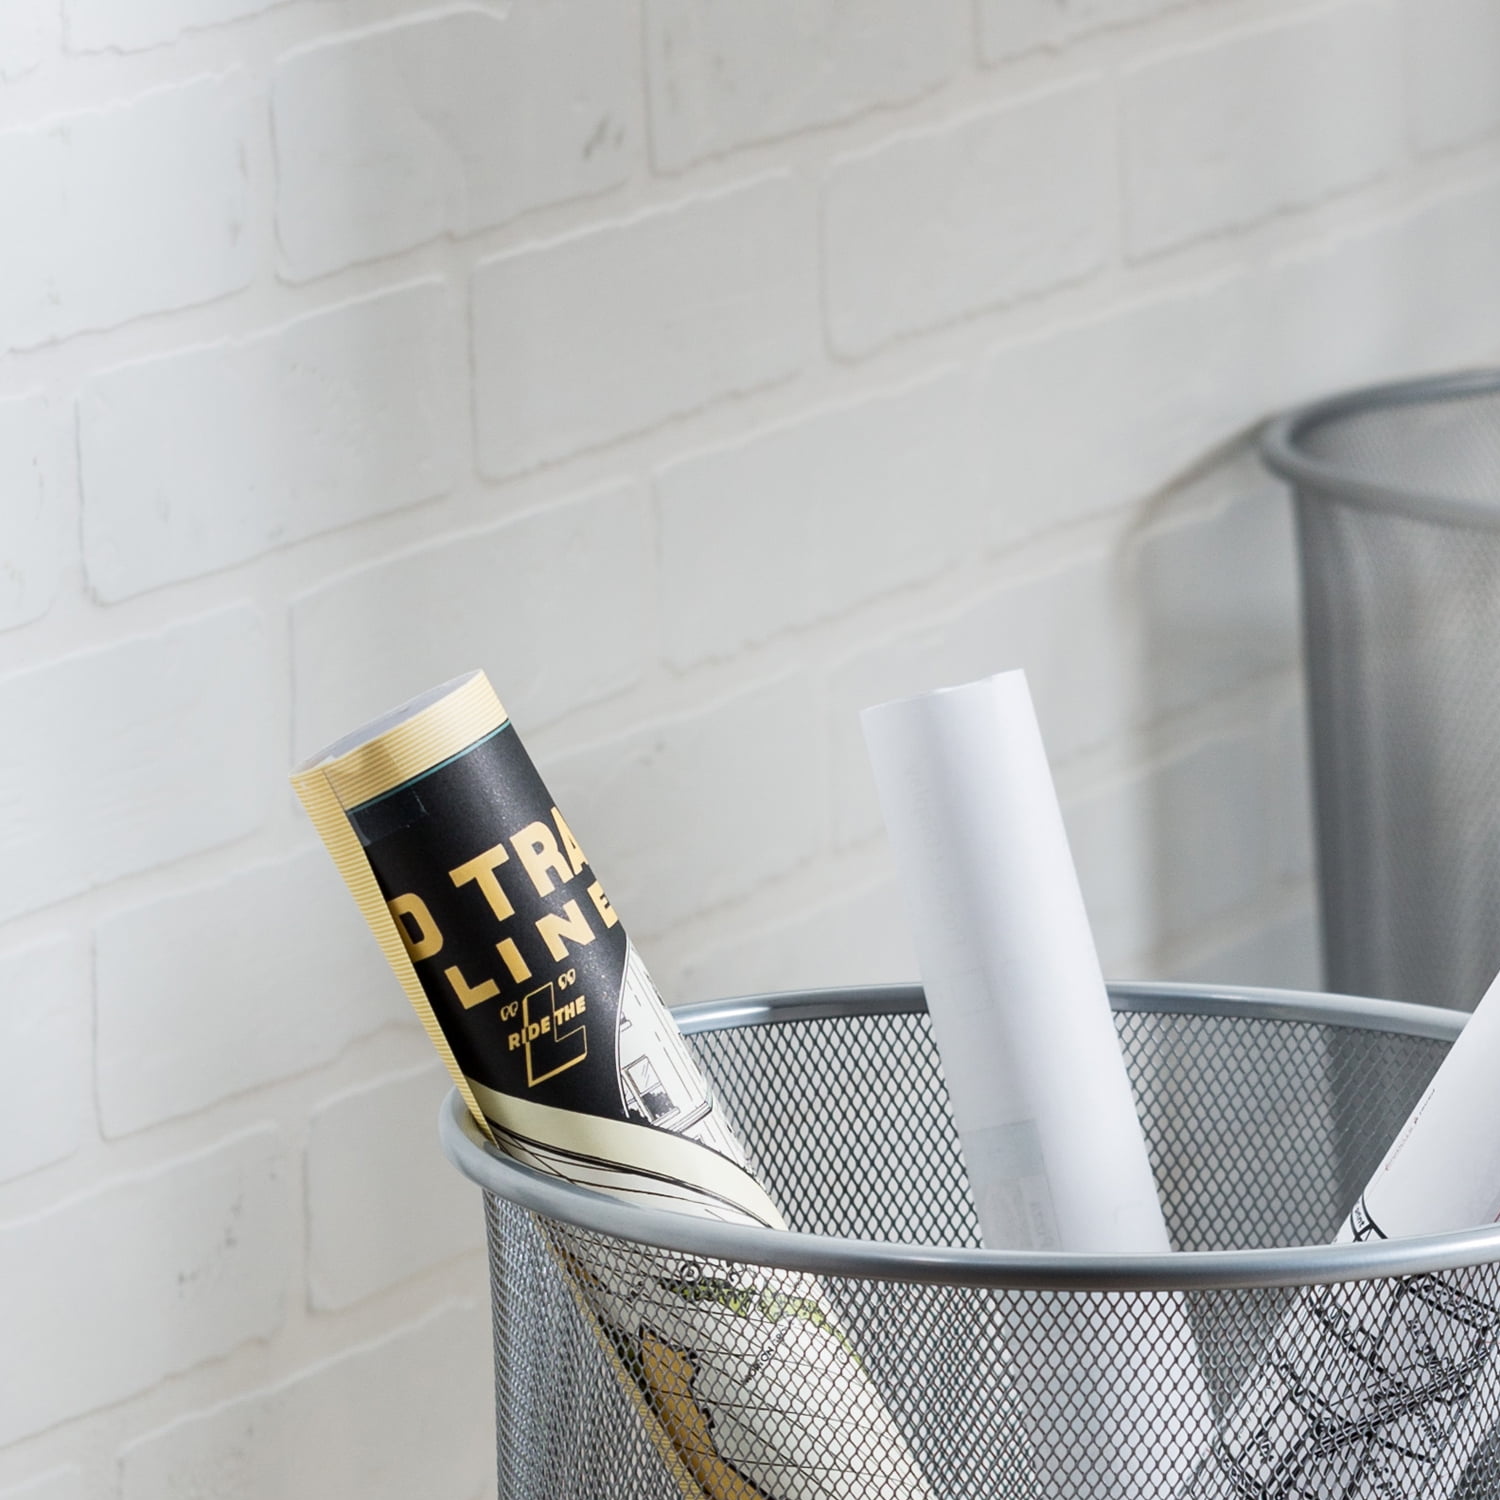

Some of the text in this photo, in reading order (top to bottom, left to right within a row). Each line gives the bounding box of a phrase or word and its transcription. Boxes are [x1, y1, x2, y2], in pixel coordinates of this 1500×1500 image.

[444, 880, 619, 1010] LINE
[508, 1016, 550, 1051] RIDE
[554, 995, 587, 1026] THE
